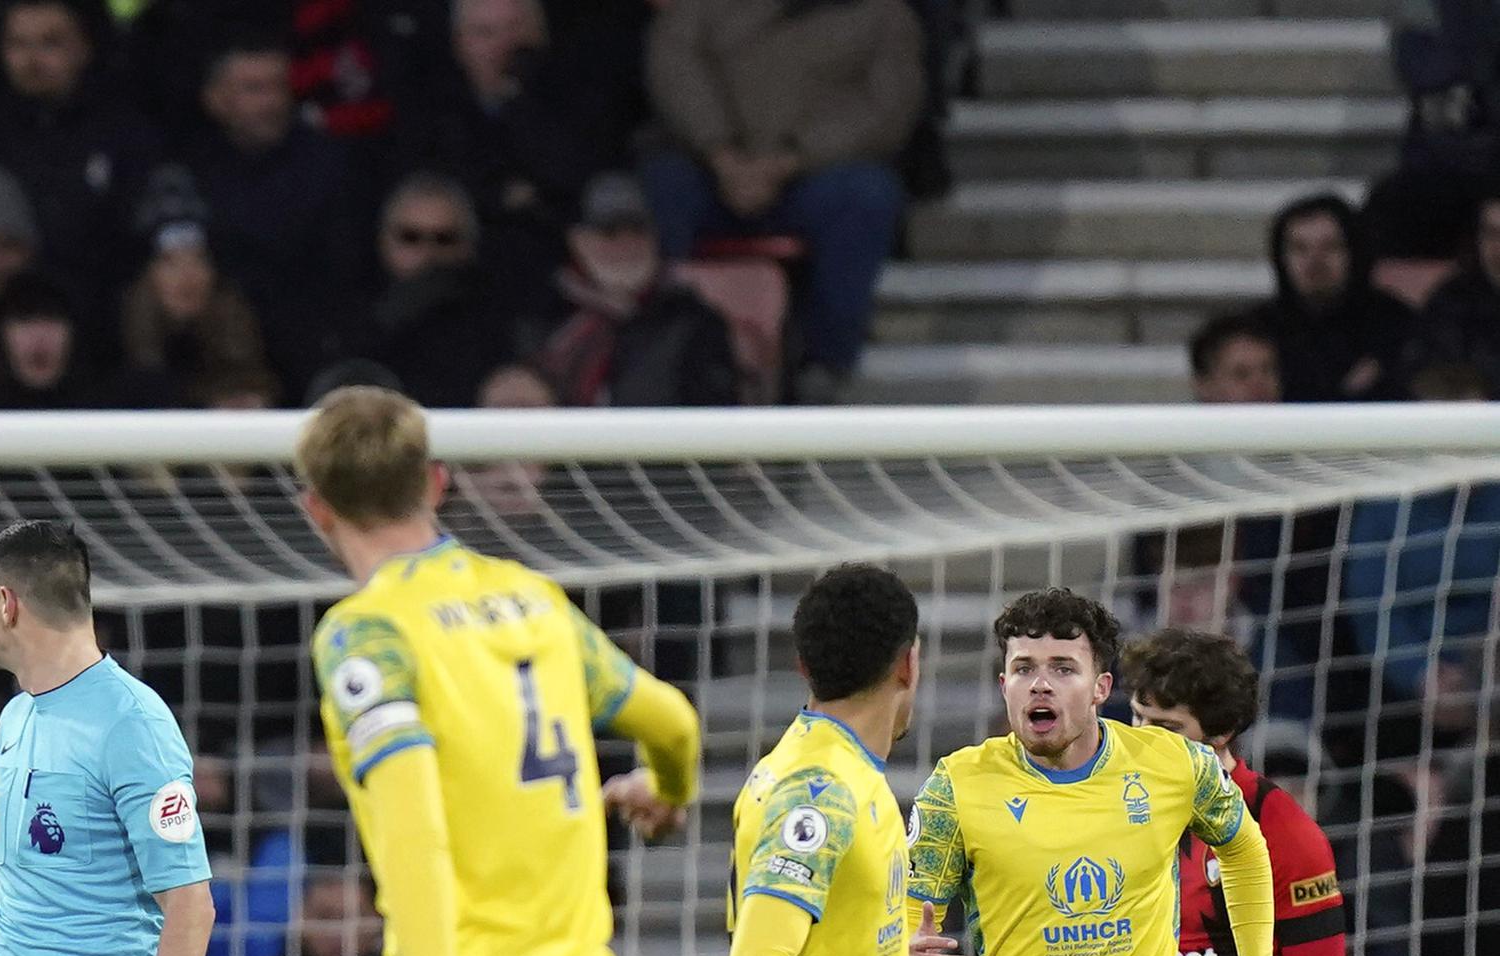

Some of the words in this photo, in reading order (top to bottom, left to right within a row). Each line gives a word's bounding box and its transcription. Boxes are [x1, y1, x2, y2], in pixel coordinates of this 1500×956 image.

[519, 659, 580, 809] 4
[160, 793, 190, 818] EA
[160, 811, 192, 829] SPOR
[1043, 918, 1132, 944] UNHCR
